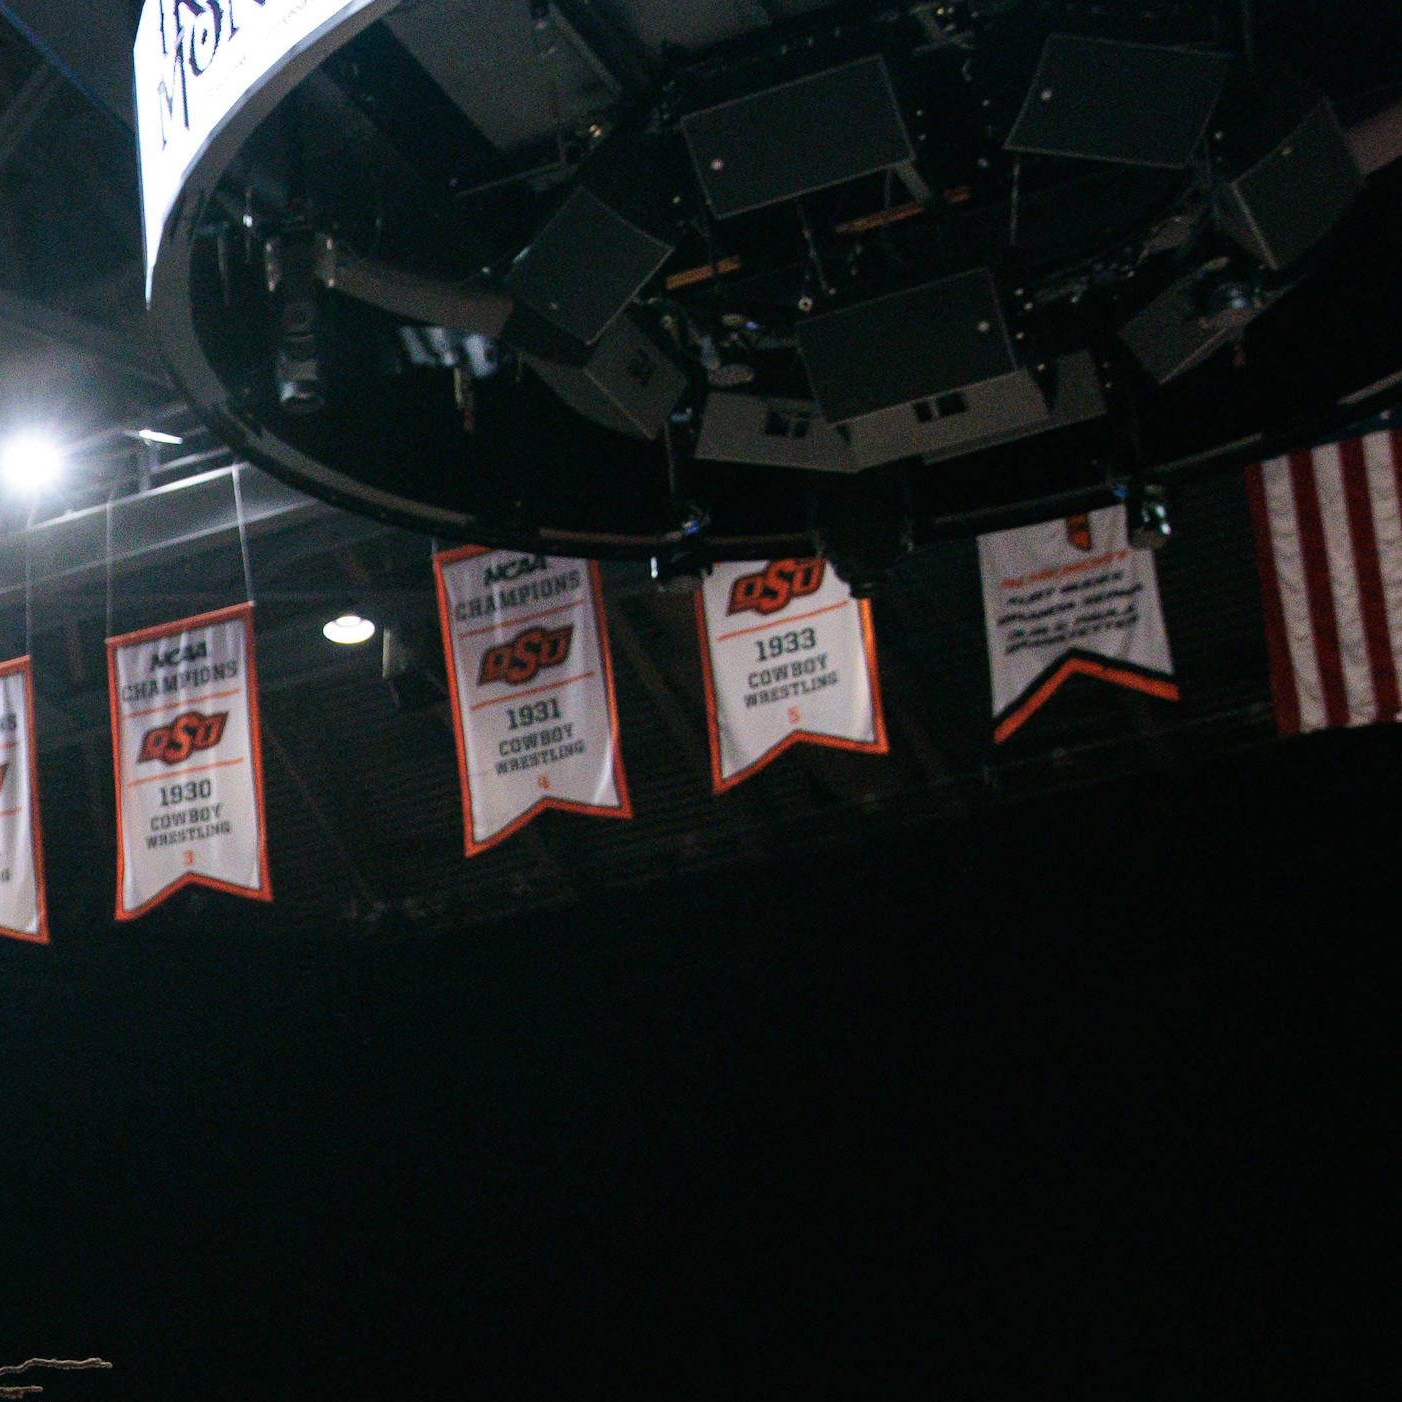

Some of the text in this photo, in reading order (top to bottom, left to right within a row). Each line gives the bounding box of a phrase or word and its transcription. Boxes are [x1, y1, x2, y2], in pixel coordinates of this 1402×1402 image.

[455, 570, 580, 621] CHAMPIONS
[727, 557, 826, 617] OSU
[150, 640, 207, 670] NCAA
[476, 624, 574, 687] OSU
[755, 627, 816, 662] 1933
[122, 660, 238, 702] CHAMPIONS
[748, 652, 828, 688] COWBOY
[744, 670, 839, 708] WRESTLING
[505, 698, 562, 730] 1931
[137, 711, 229, 766] OSU
[495, 738, 585, 775] WRESTLING
[499, 722, 573, 756] COWBOY
[159, 778, 213, 807] 1930
[146, 820, 231, 850] WRESTLING
[150, 802, 222, 832] COWBOY
